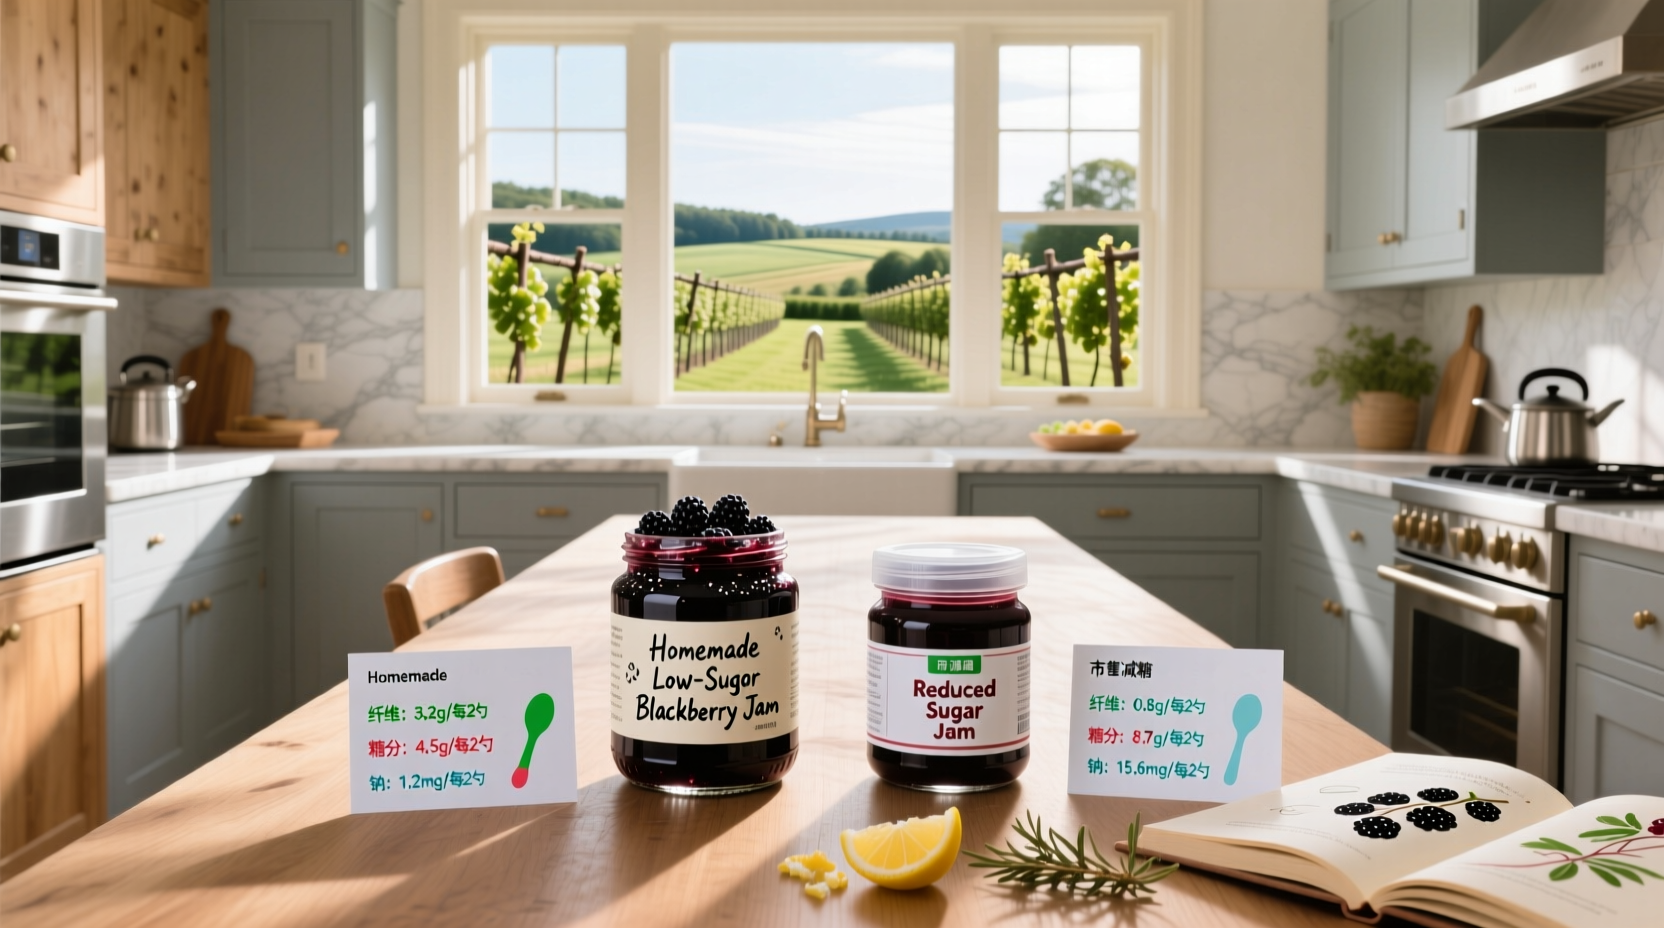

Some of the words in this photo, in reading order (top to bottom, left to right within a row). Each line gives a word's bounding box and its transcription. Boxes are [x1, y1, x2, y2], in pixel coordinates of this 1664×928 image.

[649, 632, 760, 662] Homemade
[368, 668, 447, 683] Homemade
[914, 679, 996, 698] Reduced
[636, 693, 738, 731] Blackberry
[743, 694, 779, 720] Jam
[926, 701, 984, 724] Sugar
[934, 722, 975, 739] Jam
